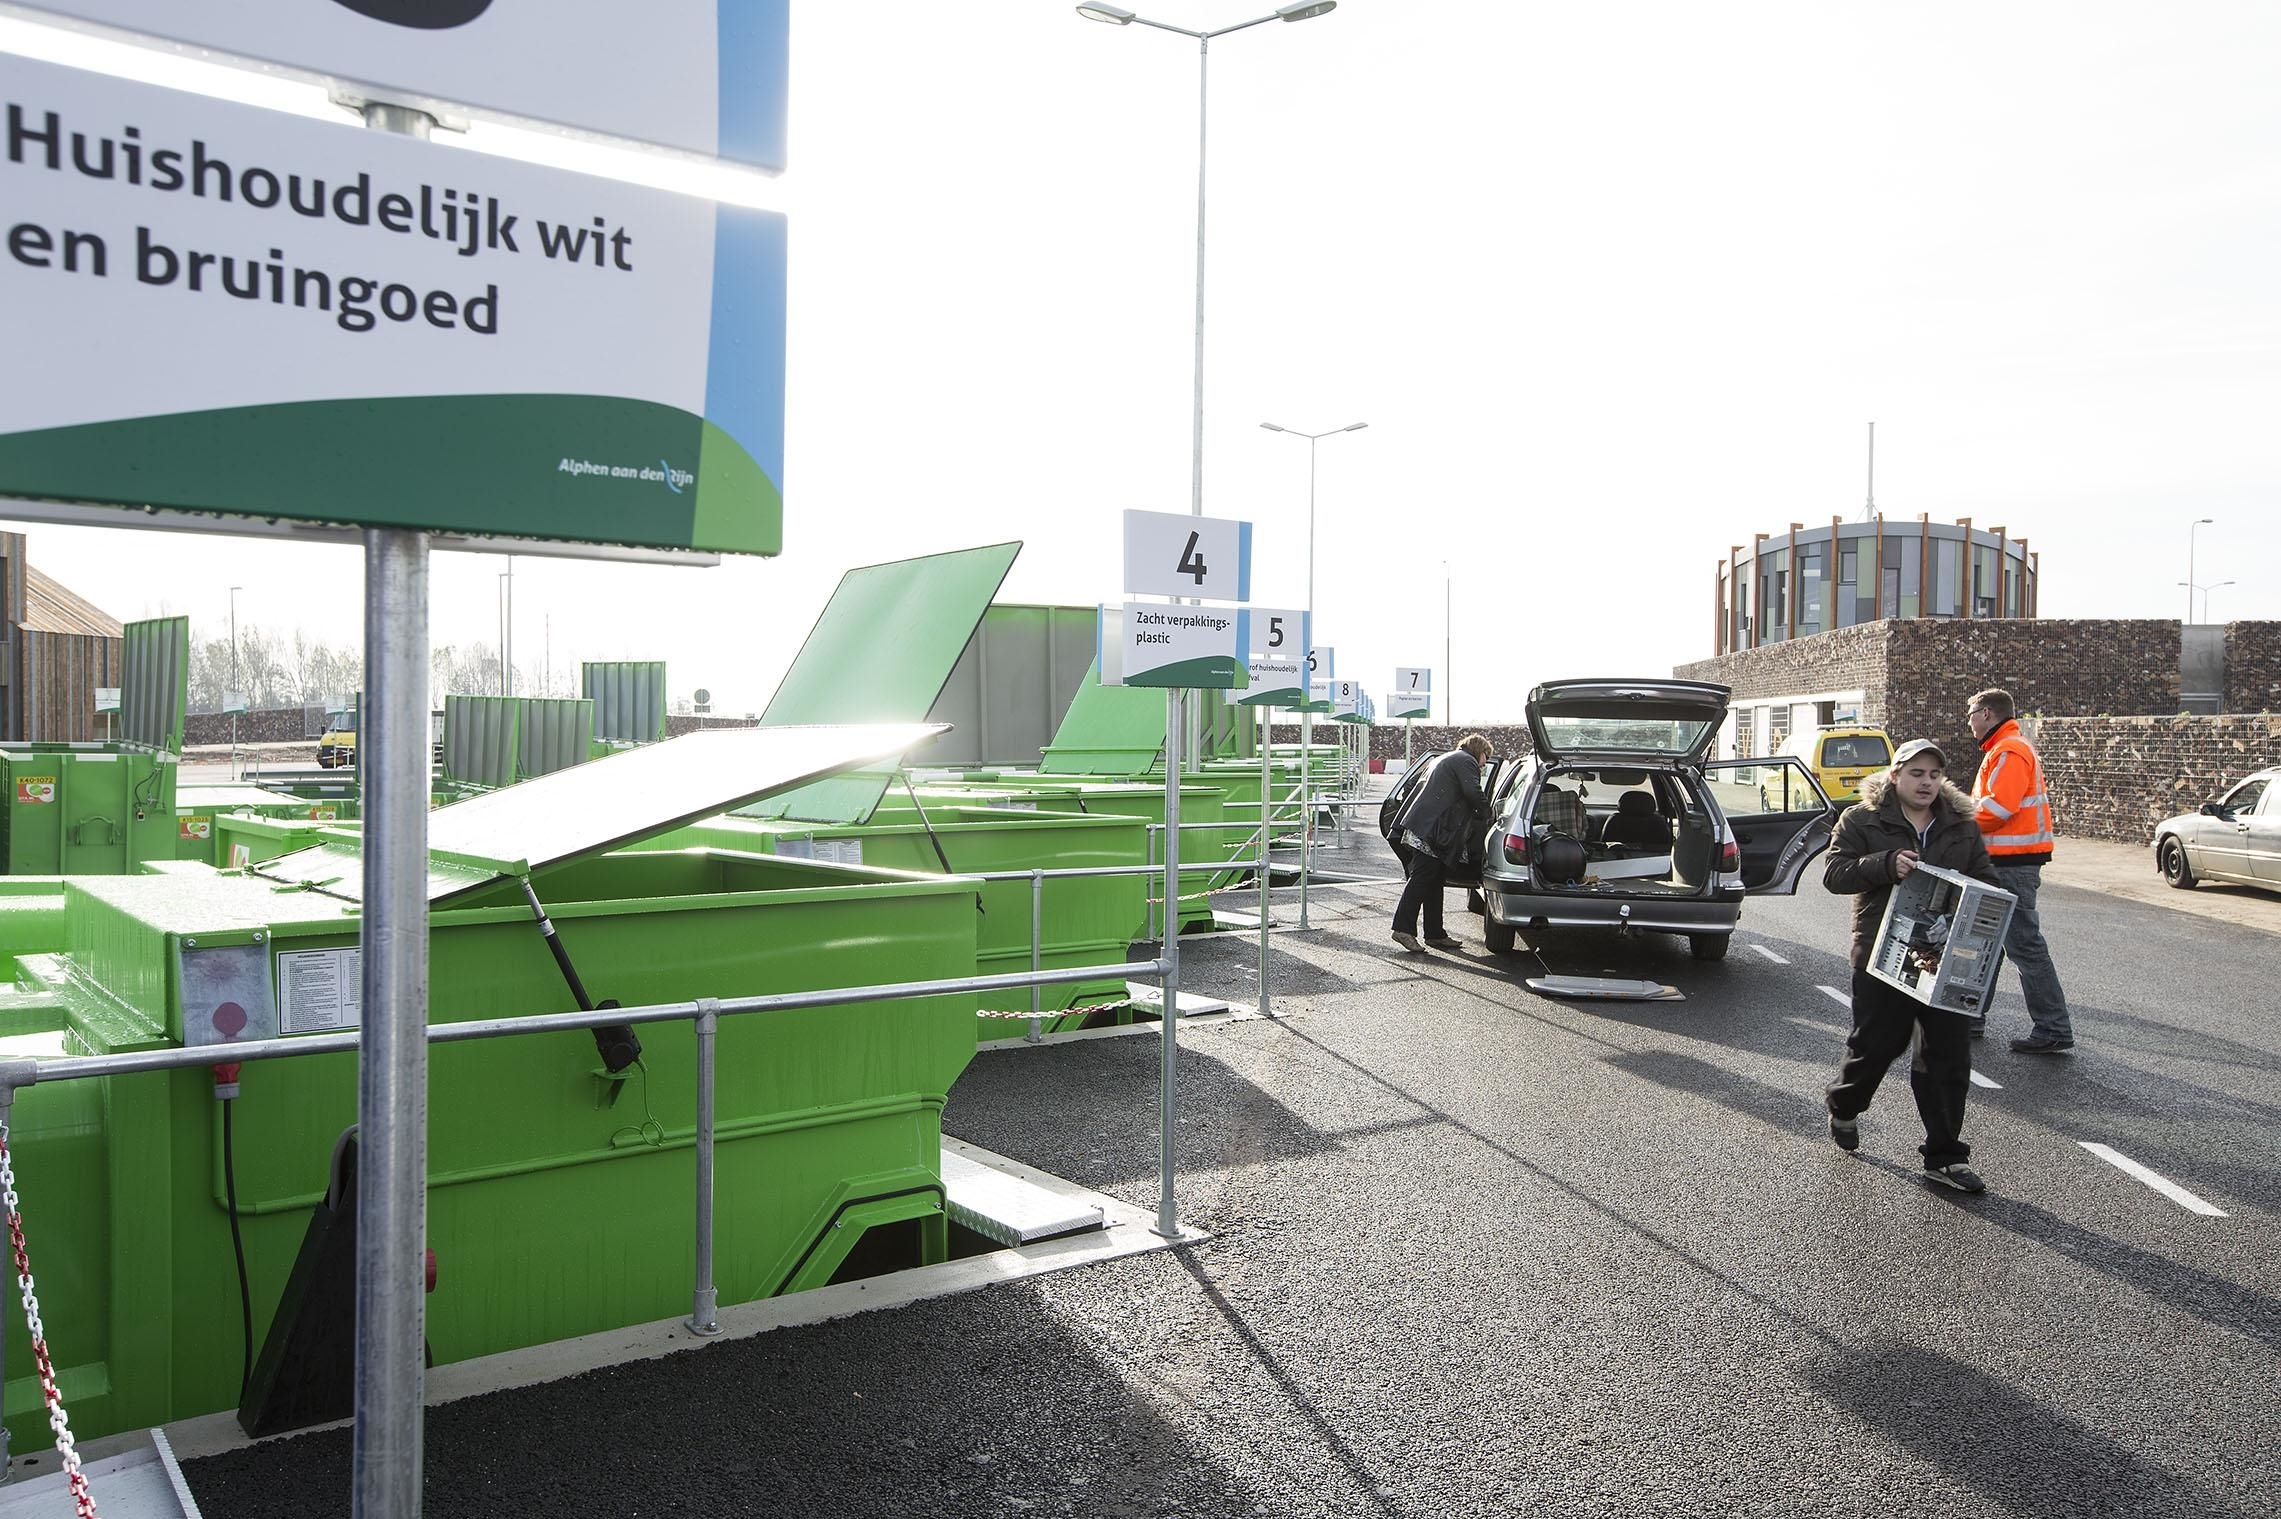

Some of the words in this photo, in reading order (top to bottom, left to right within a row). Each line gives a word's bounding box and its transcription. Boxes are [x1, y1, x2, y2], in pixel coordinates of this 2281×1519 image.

[7, 103, 519, 256] Huishoudelijk
[535, 216, 632, 271] wit
[7, 222, 107, 277] en
[136, 225, 498, 333] bruingoed
[558, 458, 609, 476] Alphen
[611, 465, 638, 479] aan
[639, 466, 665, 482] den
[1176, 530, 1207, 585] 4
[1136, 611, 1165, 625] Zacht
[1167, 614, 1230, 632] verpakkings-
[1268, 617, 1284, 647] 5
[1136, 631, 1170, 646] plastic
[1259, 664, 1298, 673] huishoudelijk
[1306, 650, 1318, 672] 6
[1342, 683, 1349, 696] 8
[1411, 672, 1419, 688] 7
